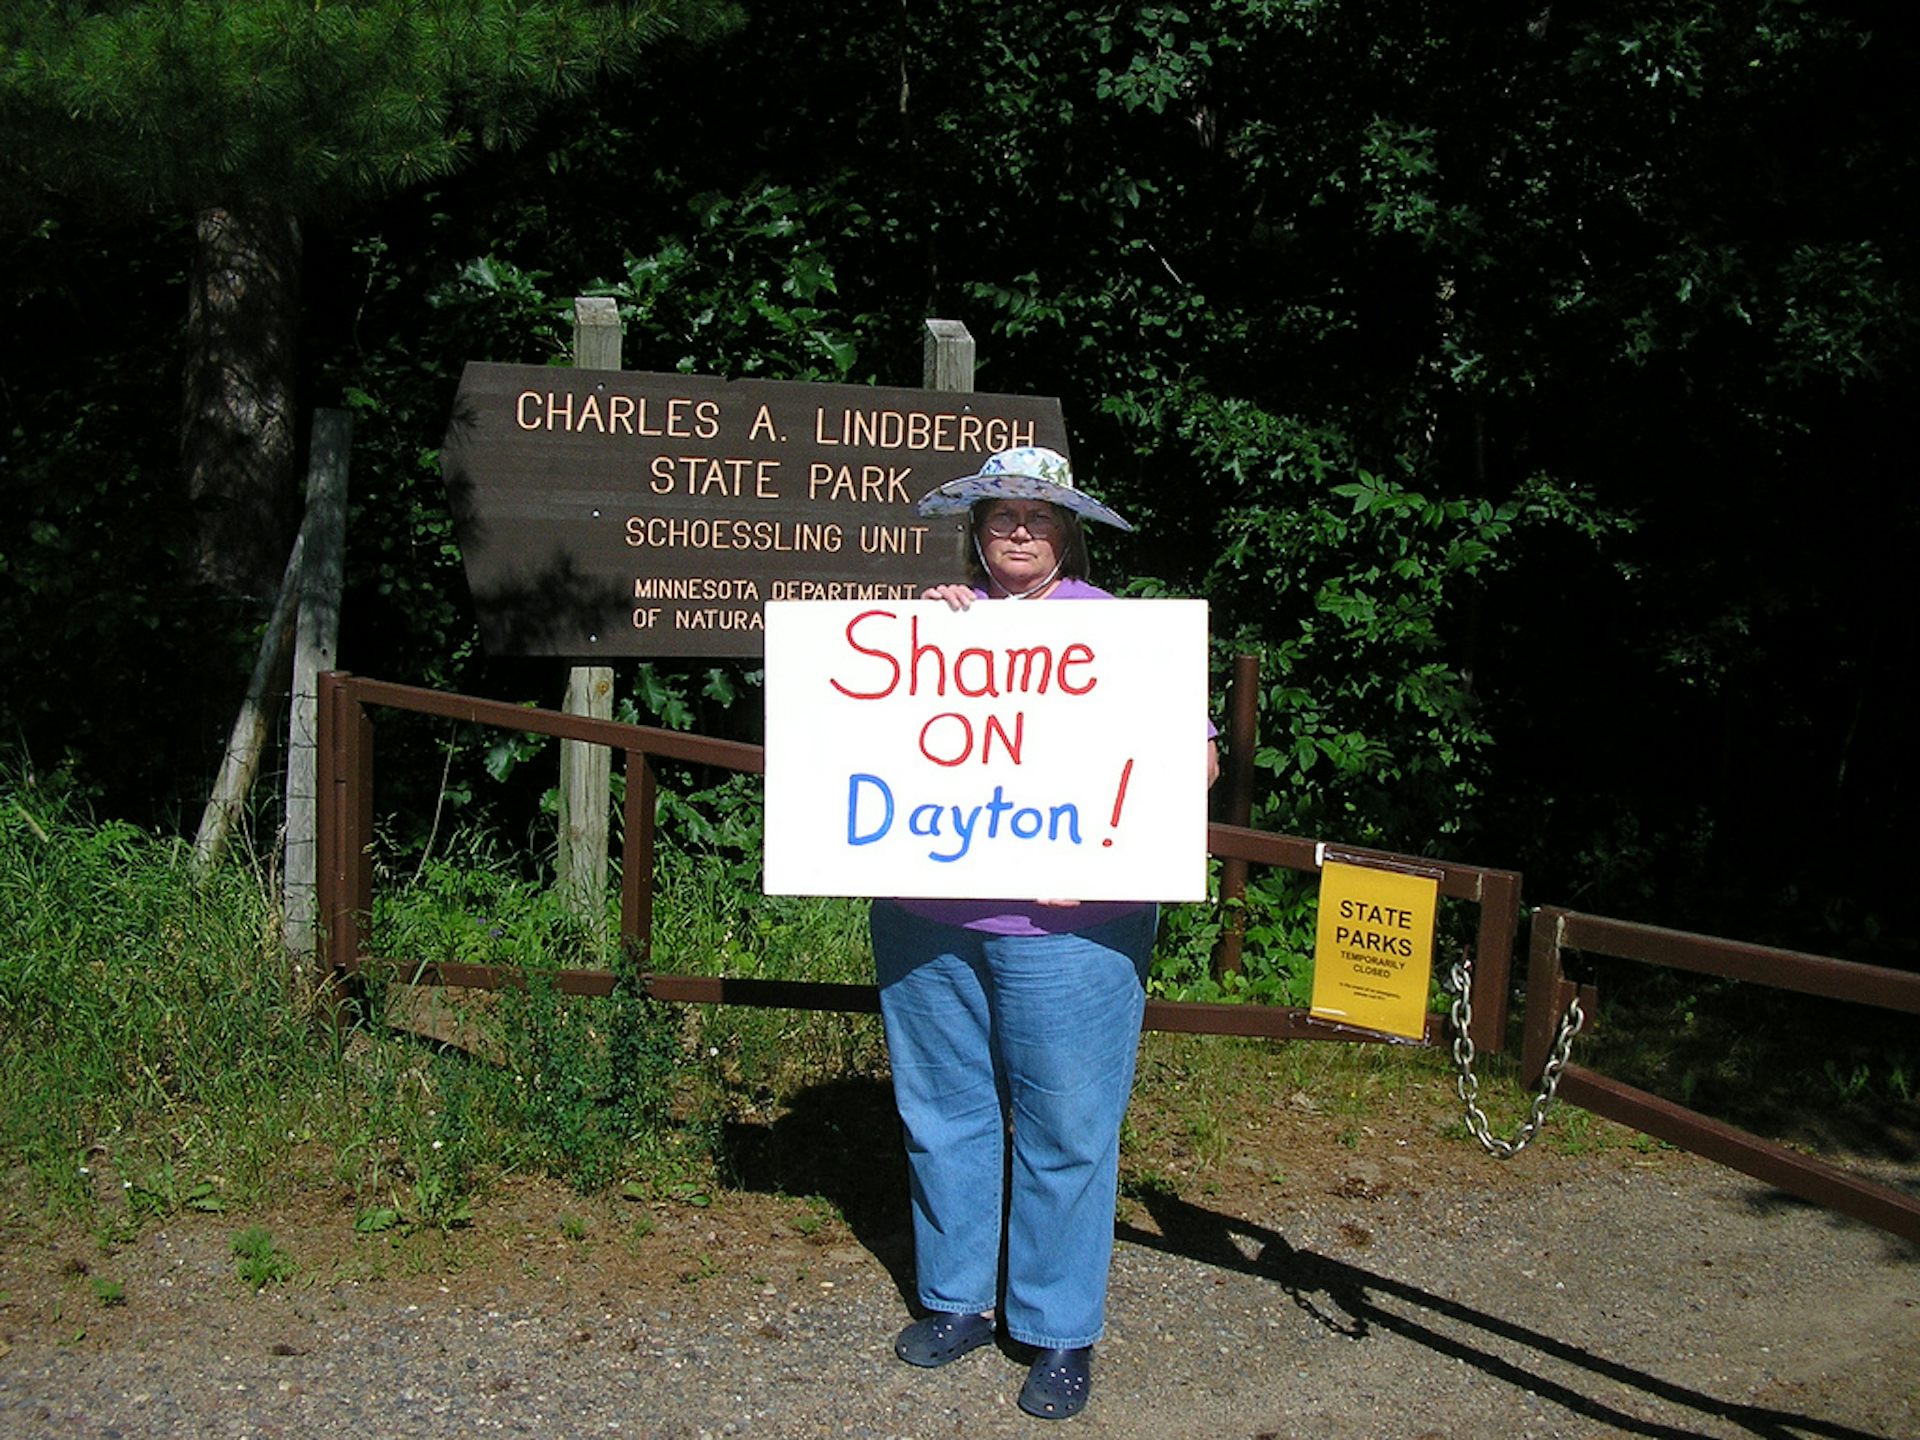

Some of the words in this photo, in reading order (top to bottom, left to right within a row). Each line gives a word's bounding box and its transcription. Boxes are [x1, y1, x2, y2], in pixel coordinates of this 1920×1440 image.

[516, 390, 720, 439] CHARLES
[749, 404, 788, 442] A.
[815, 406, 1035, 453] LINDBERGH
[649, 456, 781, 499] STATE
[808, 463, 912, 504] PARK
[624, 516, 843, 554] SCHOESSLING
[860, 526, 930, 556] UNIT
[633, 578, 759, 601] MINNESOTA
[771, 580, 918, 601] DEPARTMENT
[632, 607, 662, 630] OF
[829, 609, 1098, 701] Shame
[919, 711, 1024, 768] ON
[1340, 900, 1413, 930] STATE
[1335, 926, 1413, 957] PARKS
[1340, 950, 1406, 971] TEMPORARILY
[1352, 964, 1392, 979] CLOSED
